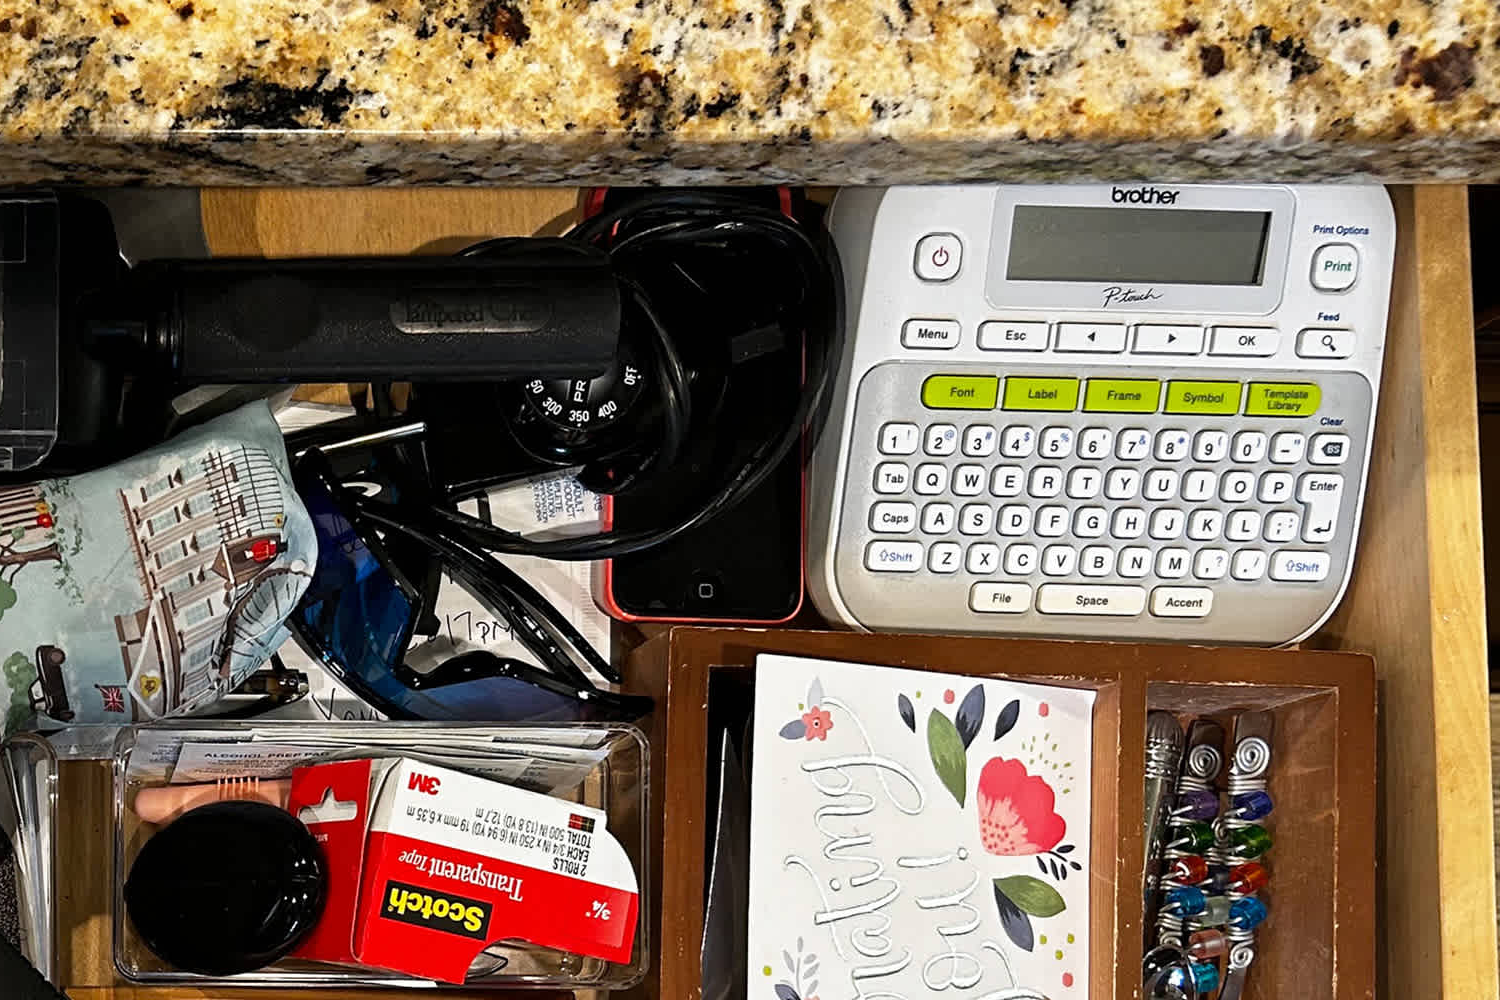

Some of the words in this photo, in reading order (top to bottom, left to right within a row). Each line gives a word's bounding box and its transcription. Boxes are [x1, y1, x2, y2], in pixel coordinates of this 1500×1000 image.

[1112, 187, 1180, 204] brother
[1313, 225, 1334, 234] Print
[1336, 226, 1369, 236] Options
[1324, 261, 1352, 272] Print
[1317, 313, 1340, 321] Feed
[917, 328, 949, 340] Menu
[1005, 330, 1027, 341] Esc
[1238, 336, 1256, 346] OK
[624, 366, 638, 386] OFF
[950, 387, 975, 398] Font
[1028, 388, 1057, 399] Label
[1107, 391, 1141, 400] Frame
[1183, 393, 1224, 404] Symbol
[1264, 389, 1309, 401] Template
[542, 397, 562, 416] 300
[569, 410, 589, 422] 350
[598, 400, 617, 418] 400
[1267, 399, 1302, 412] Library
[1320, 416, 1344, 426] Clear
[891, 437, 897, 448] 1
[934, 437, 943, 449] 2
[973, 438, 982, 450] 3
[1011, 439, 1020, 450] 4
[1050, 440, 1059, 451] 5
[1088, 441, 1097, 452] 6
[1128, 441, 1136, 452] 7
[1165, 442, 1174, 454] 8
[1204, 444, 1213, 455] 9
[1243, 445, 1251, 456] 0
[885, 473, 904, 483] Tab
[926, 474, 938, 487] Q
[965, 475, 979, 487] W
[1005, 476, 1014, 487] E
[1043, 477, 1053, 488] R
[1084, 478, 1092, 489] T
[1121, 478, 1130, 490] Y
[1159, 480, 1169, 491] U
[1234, 481, 1246, 493] O
[1274, 482, 1284, 494] P
[1310, 481, 1337, 491] Enter
[882, 514, 909, 525] Caps
[934, 513, 944, 525] A
[973, 514, 983, 526] S
[1011, 515, 1022, 527] D
[1050, 516, 1060, 527] F
[1087, 516, 1099, 528] G
[1126, 518, 1137, 529] H
[1165, 519, 1174, 531] J
[1202, 519, 1213, 531] K
[1242, 520, 1250, 532] L
[889, 551, 913, 562] Shift
[942, 553, 951, 564] Z
[980, 553, 990, 565] X
[1018, 554, 1028, 566] C
[1057, 555, 1066, 567] V
[1094, 556, 1104, 568] B
[1131, 556, 1143, 569] N
[1169, 558, 1182, 569] M
[1295, 561, 1319, 573] Shift
[992, 592, 1012, 603] File
[1076, 594, 1109, 606] Space
[1165, 596, 1203, 608] Accent
[408, 772, 441, 795] 3M
[407, 805, 414, 816] m
[476, 807, 483, 817] m
[444, 816, 458, 828] mm
[485, 809, 504, 825] 12,7
[504, 815, 519, 829] YD)
[460, 821, 470, 832] 19
[550, 824, 566, 838] 500
[508, 834, 518, 846] IN
[517, 835, 535, 849] 250
[567, 831, 591, 849] TOTAL
[541, 841, 552, 852] IN
[553, 843, 567, 856] 3/4
[398, 850, 427, 872] Tape
[567, 847, 590, 863] EACH
[552, 857, 580, 875] ROLLS
[580, 864, 587, 877] 2
[428, 861, 523, 902] Transparent
[389, 888, 485, 932] Scotch
